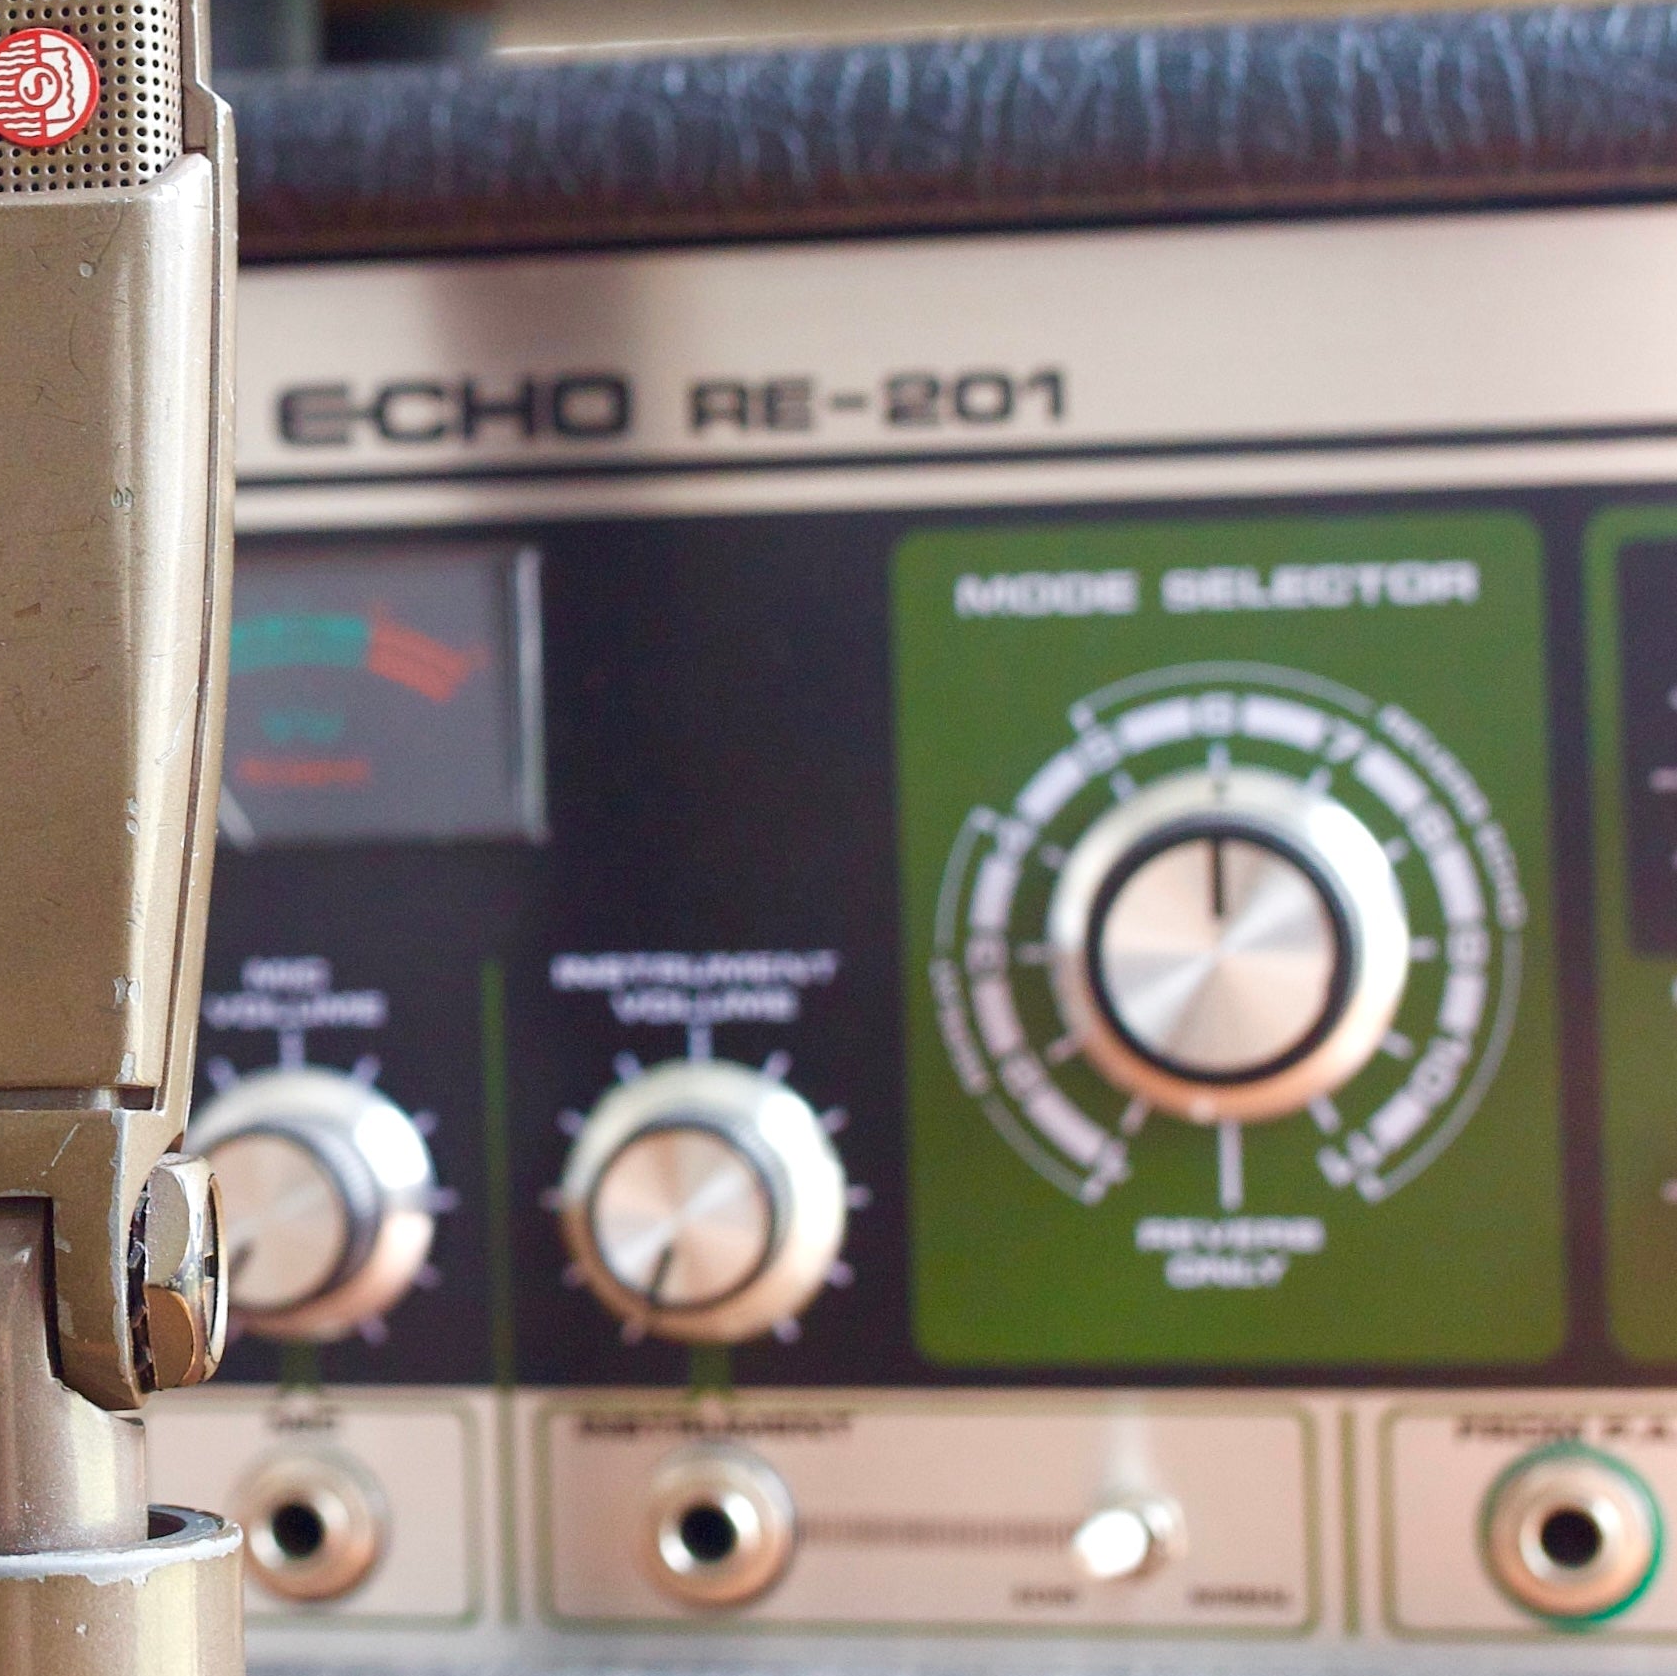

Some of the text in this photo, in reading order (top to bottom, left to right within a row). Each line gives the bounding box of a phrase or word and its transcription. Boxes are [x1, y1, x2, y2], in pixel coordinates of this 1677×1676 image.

[276, 365, 1069, 446] ECHO RE-201
[956, 559, 1480, 619] MODE SELECTOR
[549, 949, 841, 992] INSTRUMENT
[611, 988, 799, 1022] VOLUME
